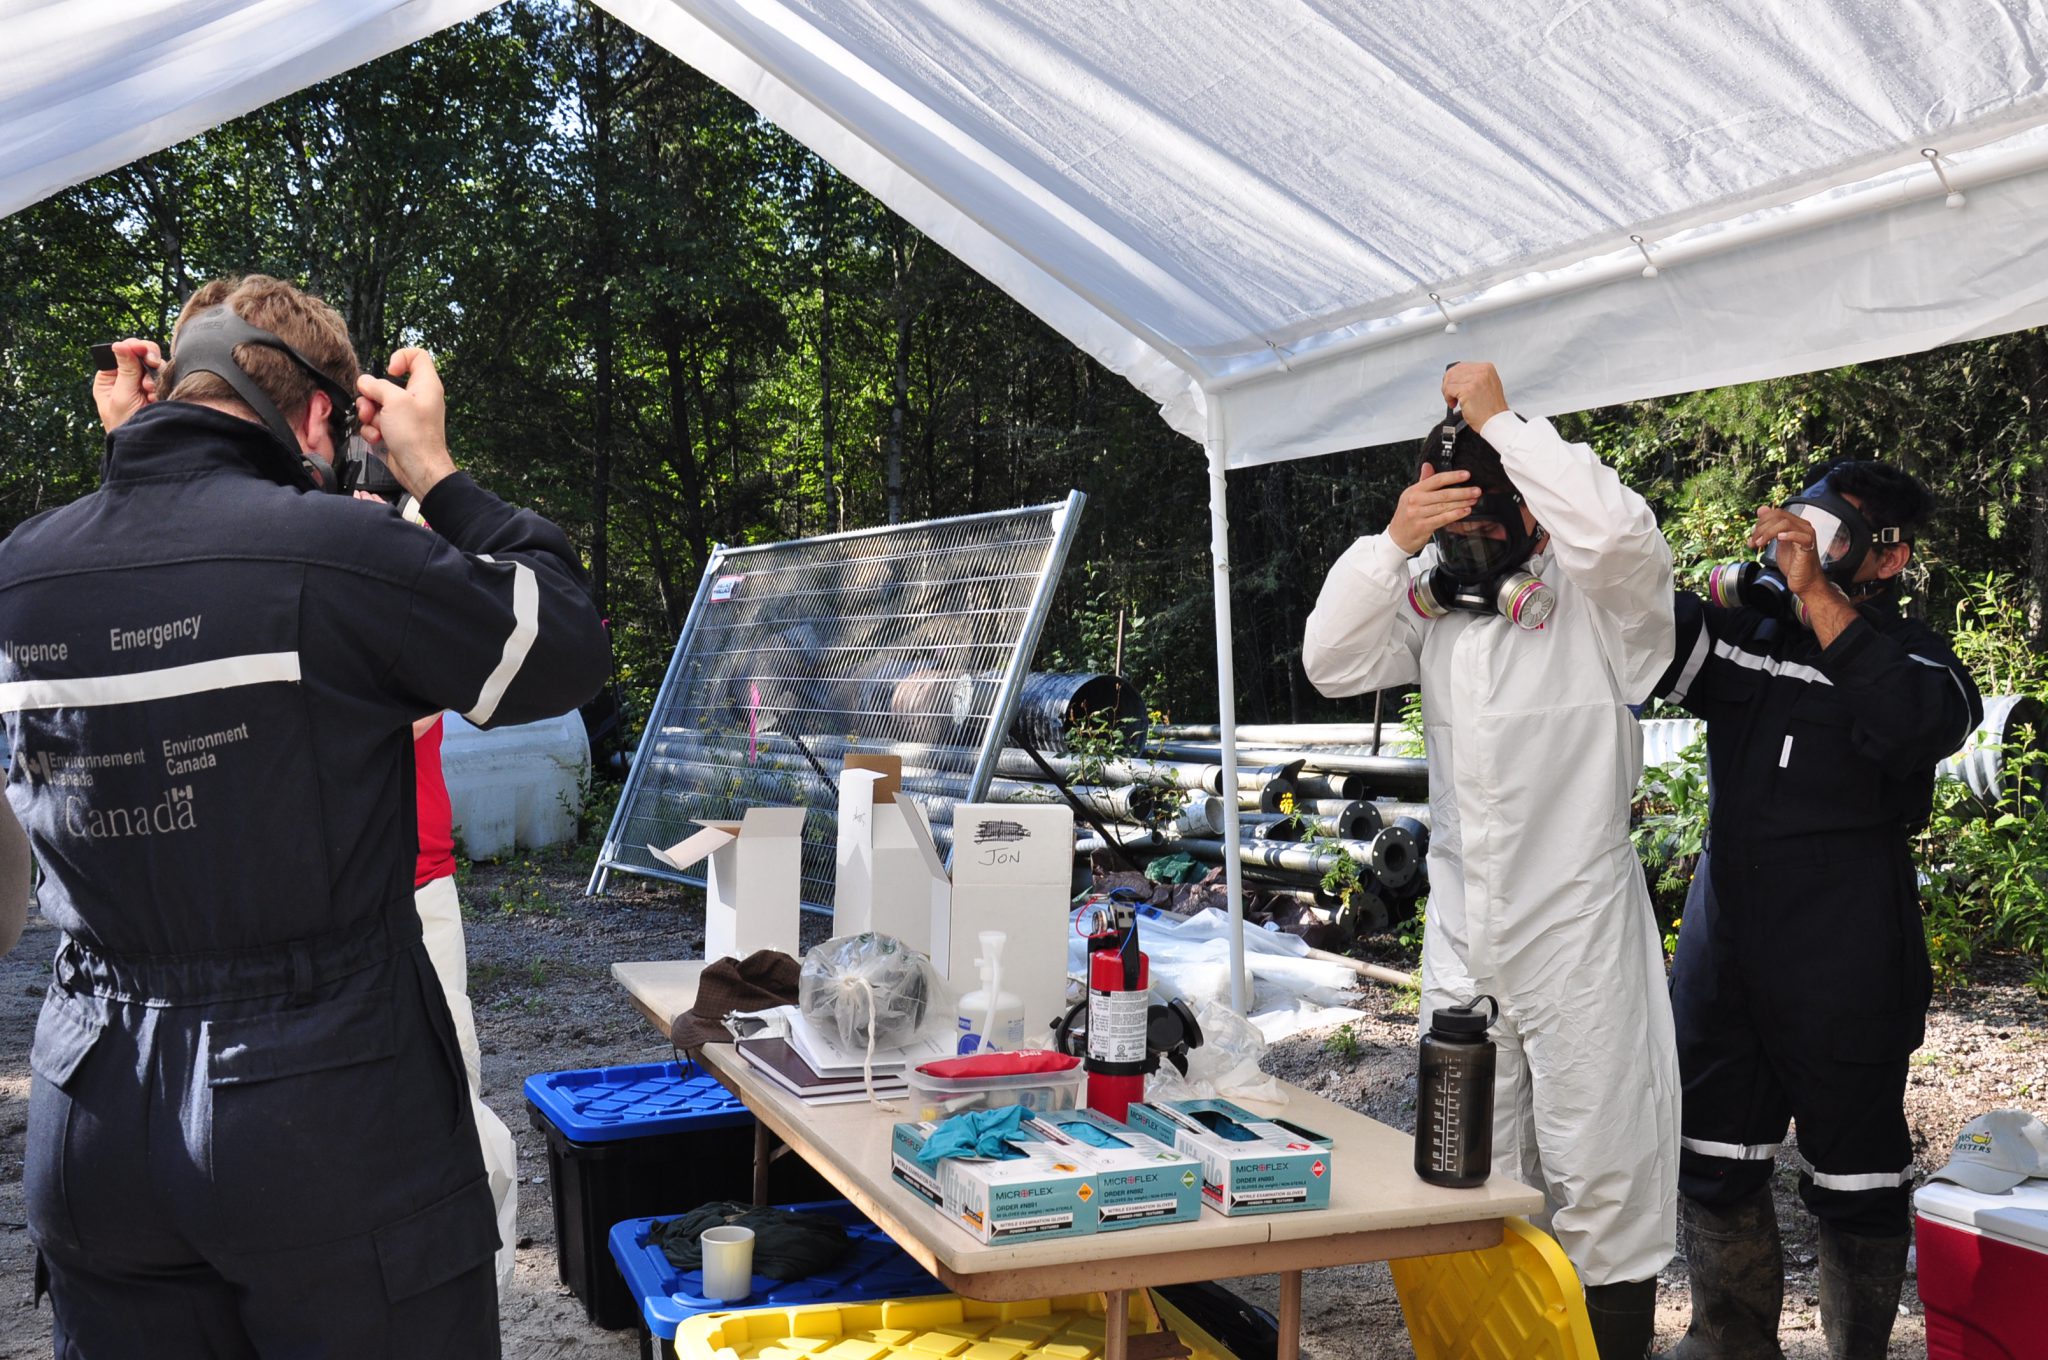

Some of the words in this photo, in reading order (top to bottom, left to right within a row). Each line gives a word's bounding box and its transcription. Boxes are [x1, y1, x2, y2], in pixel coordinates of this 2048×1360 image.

[110, 614, 202, 651] Emergency
[5, 640, 68, 667] Urgence
[162, 722, 249, 757] Environment
[48, 748, 145, 768] Environnement
[166, 752, 217, 776] Canada
[52, 770, 94, 787] Canada
[65, 789, 198, 838] Canada
[978, 847, 1020, 866] JON
[1955, 1143, 1991, 1153] ASTERS
[1236, 1162, 1289, 1173] MICROFLEX
[1104, 1174, 1158, 1186] MICROFLEX
[995, 1187, 1053, 1200] MICROFLEX
[1104, 1189, 1125, 1198] ORDER
[996, 1203, 1019, 1212] ORDER
